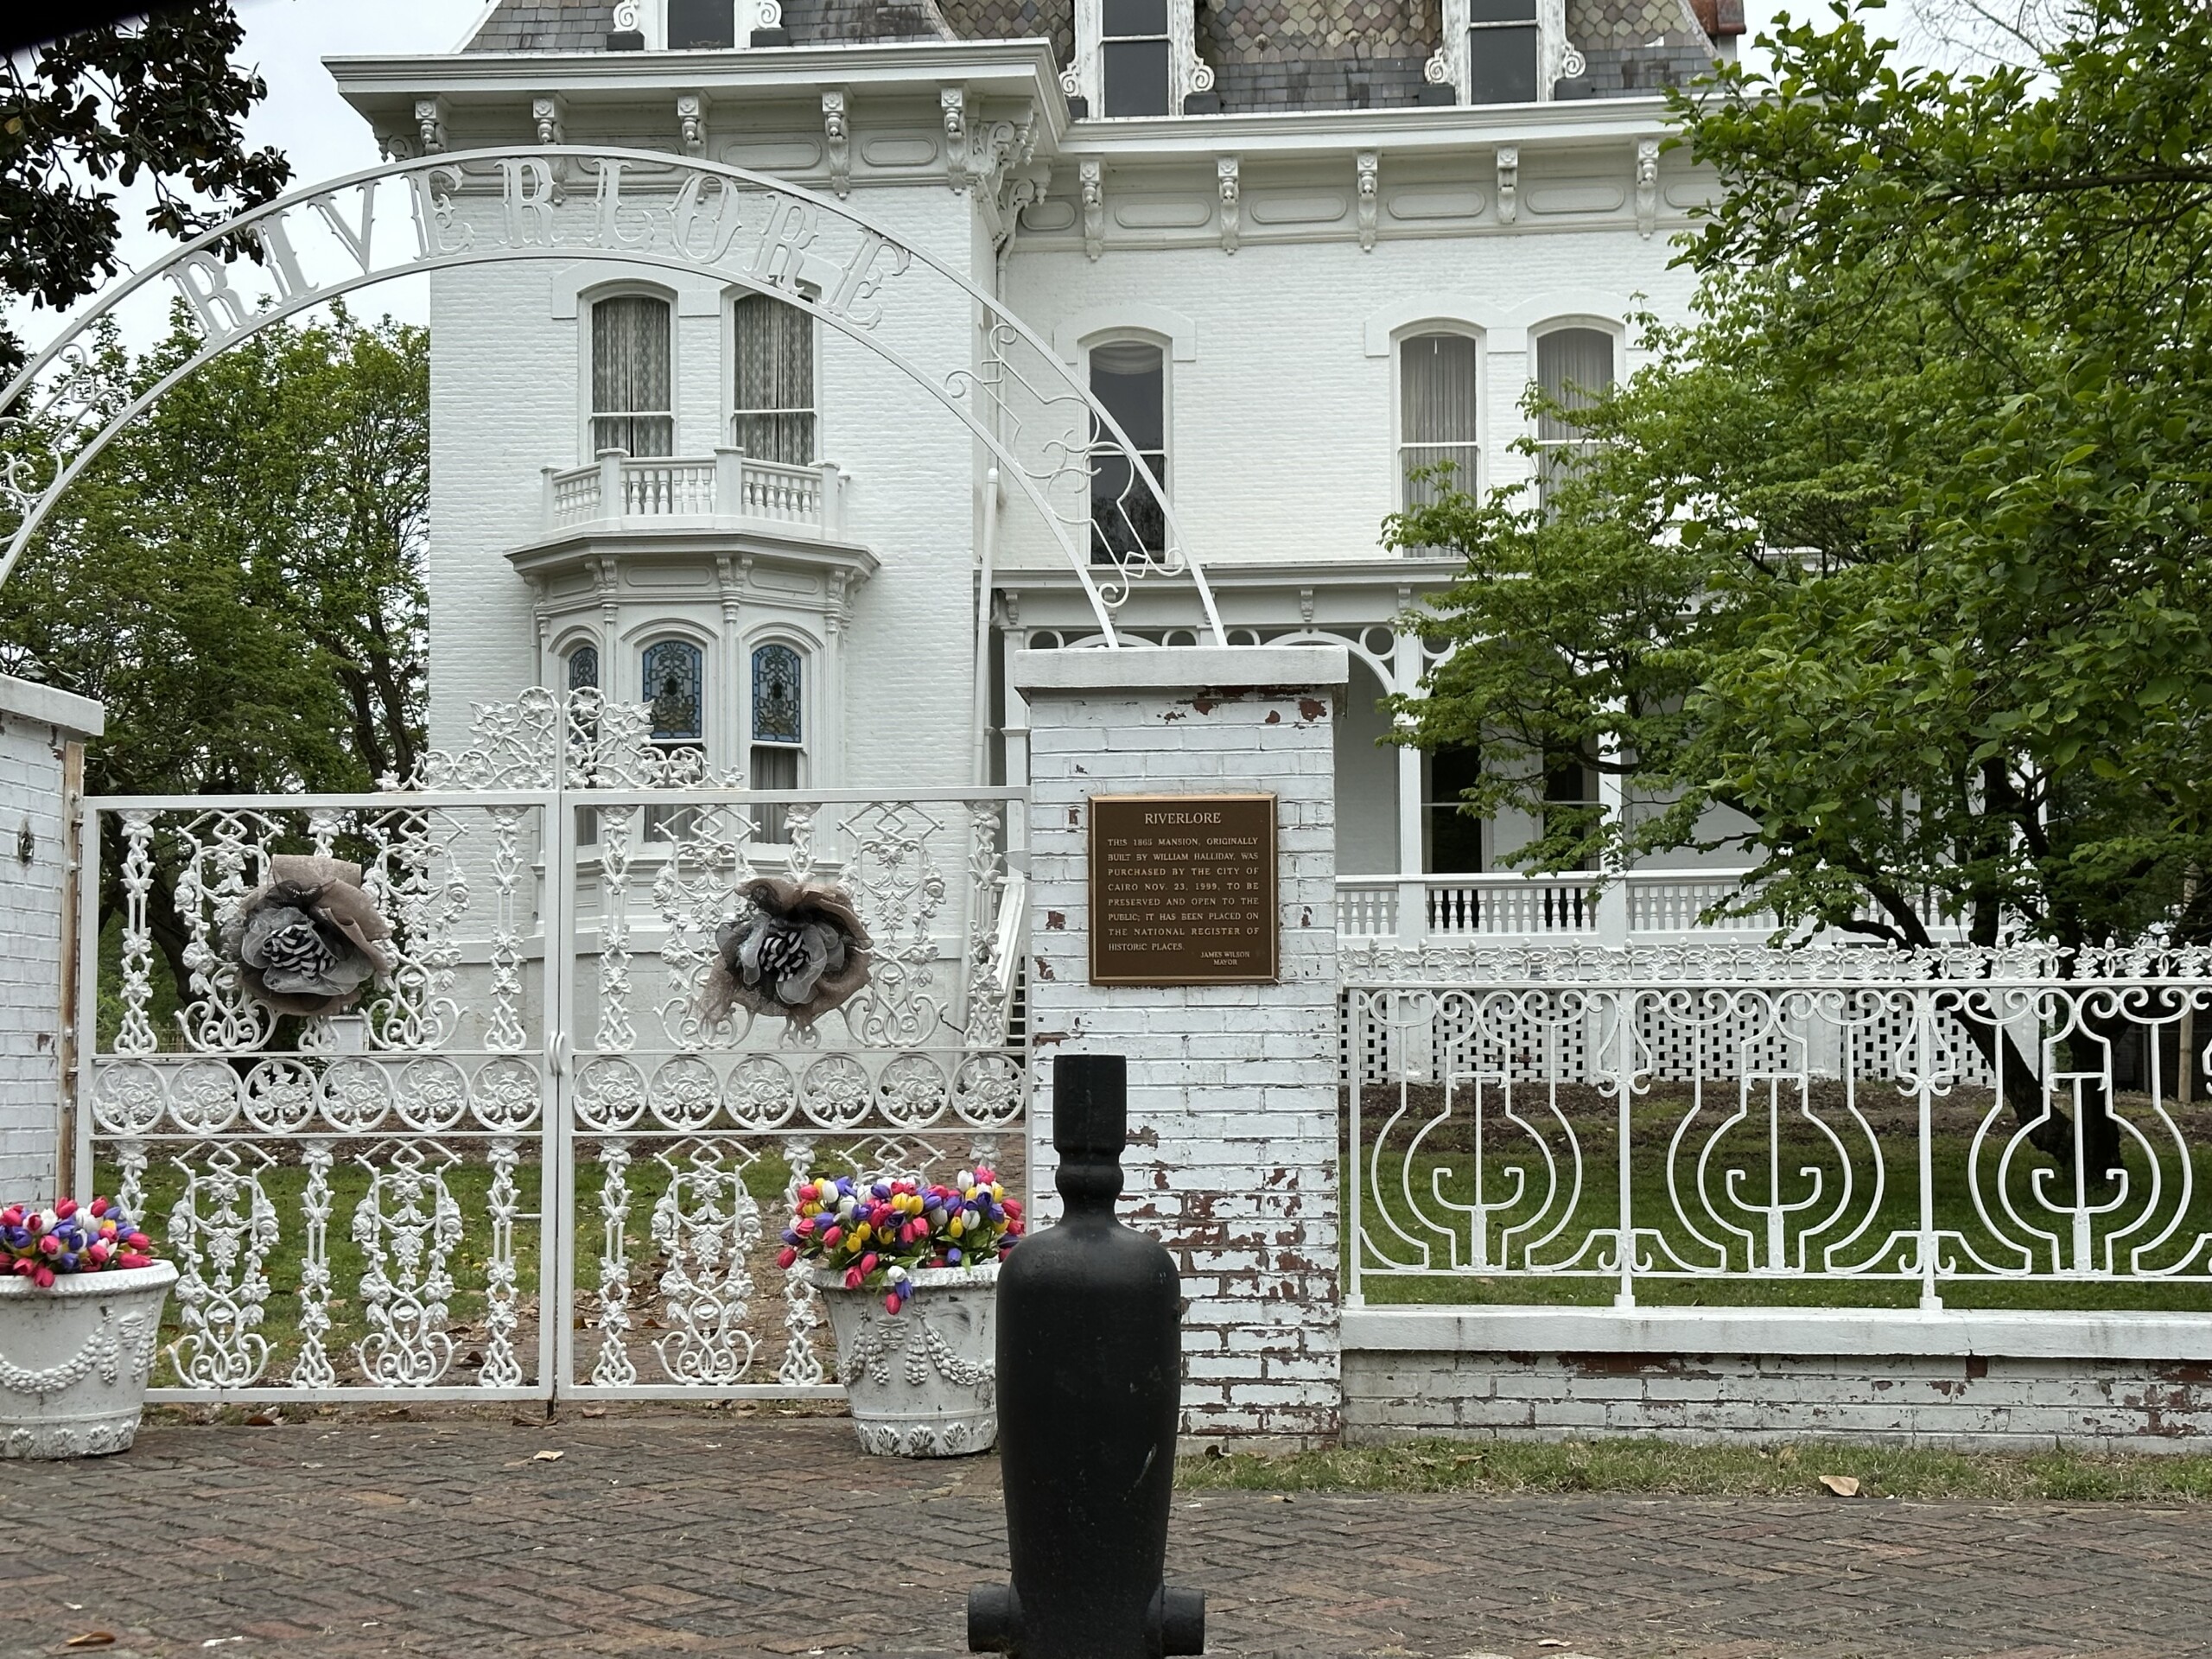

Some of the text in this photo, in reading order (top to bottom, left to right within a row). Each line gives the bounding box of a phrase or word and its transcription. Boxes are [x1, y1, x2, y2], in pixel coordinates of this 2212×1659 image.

[162, 156, 912, 344] RIVERLORE
[1145, 812, 1221, 825] RIVERLORE
[1194, 853, 1236, 861] HALLIDAY,
[1108, 883, 1138, 892] CAIRO
[1192, 927, 1241, 936] REGISTER
